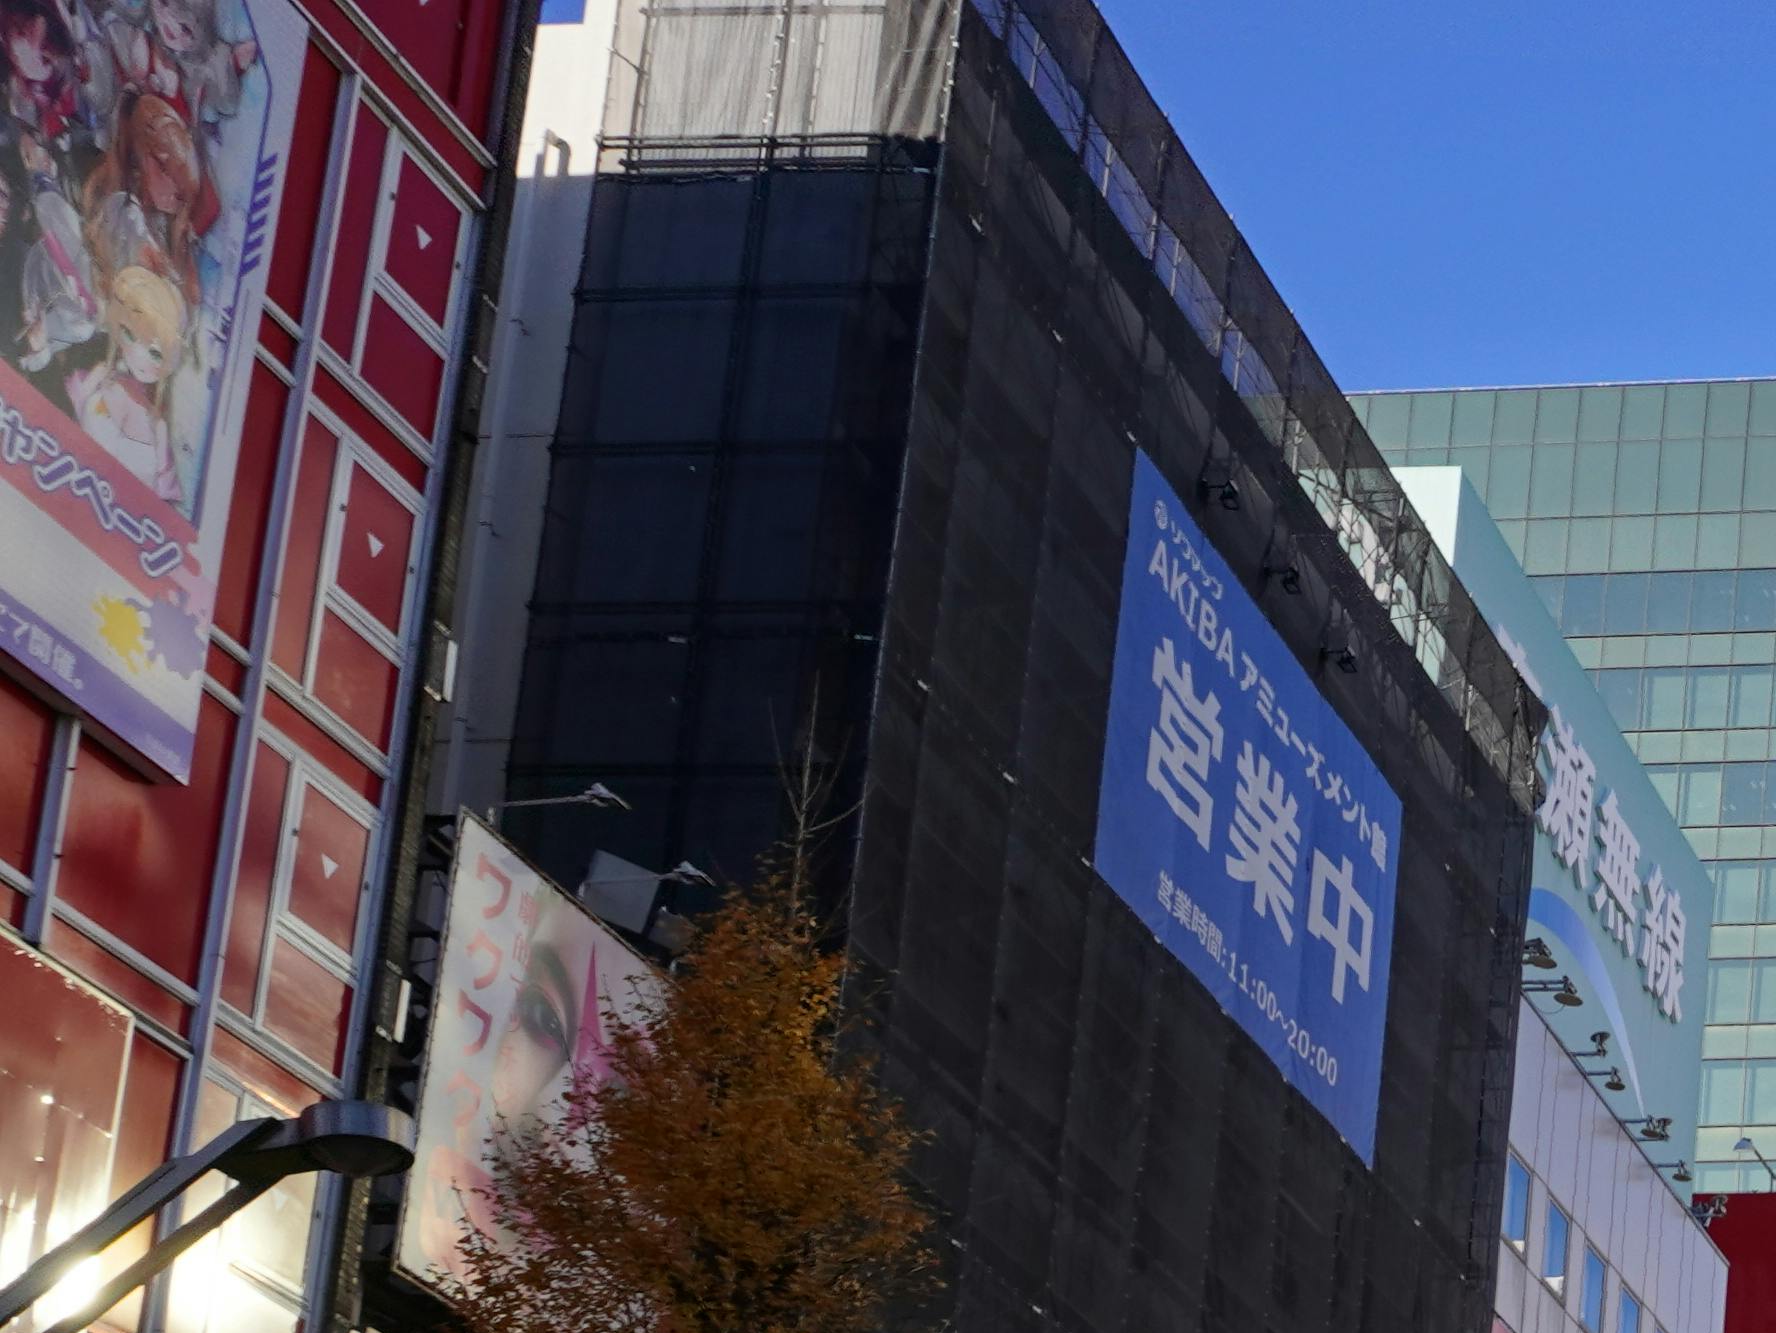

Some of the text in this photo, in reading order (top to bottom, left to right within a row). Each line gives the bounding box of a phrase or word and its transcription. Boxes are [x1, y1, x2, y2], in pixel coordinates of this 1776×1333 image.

[1147, 540, 1235, 680] AKIBA
[1146, 636, 1374, 1005] 営業中
